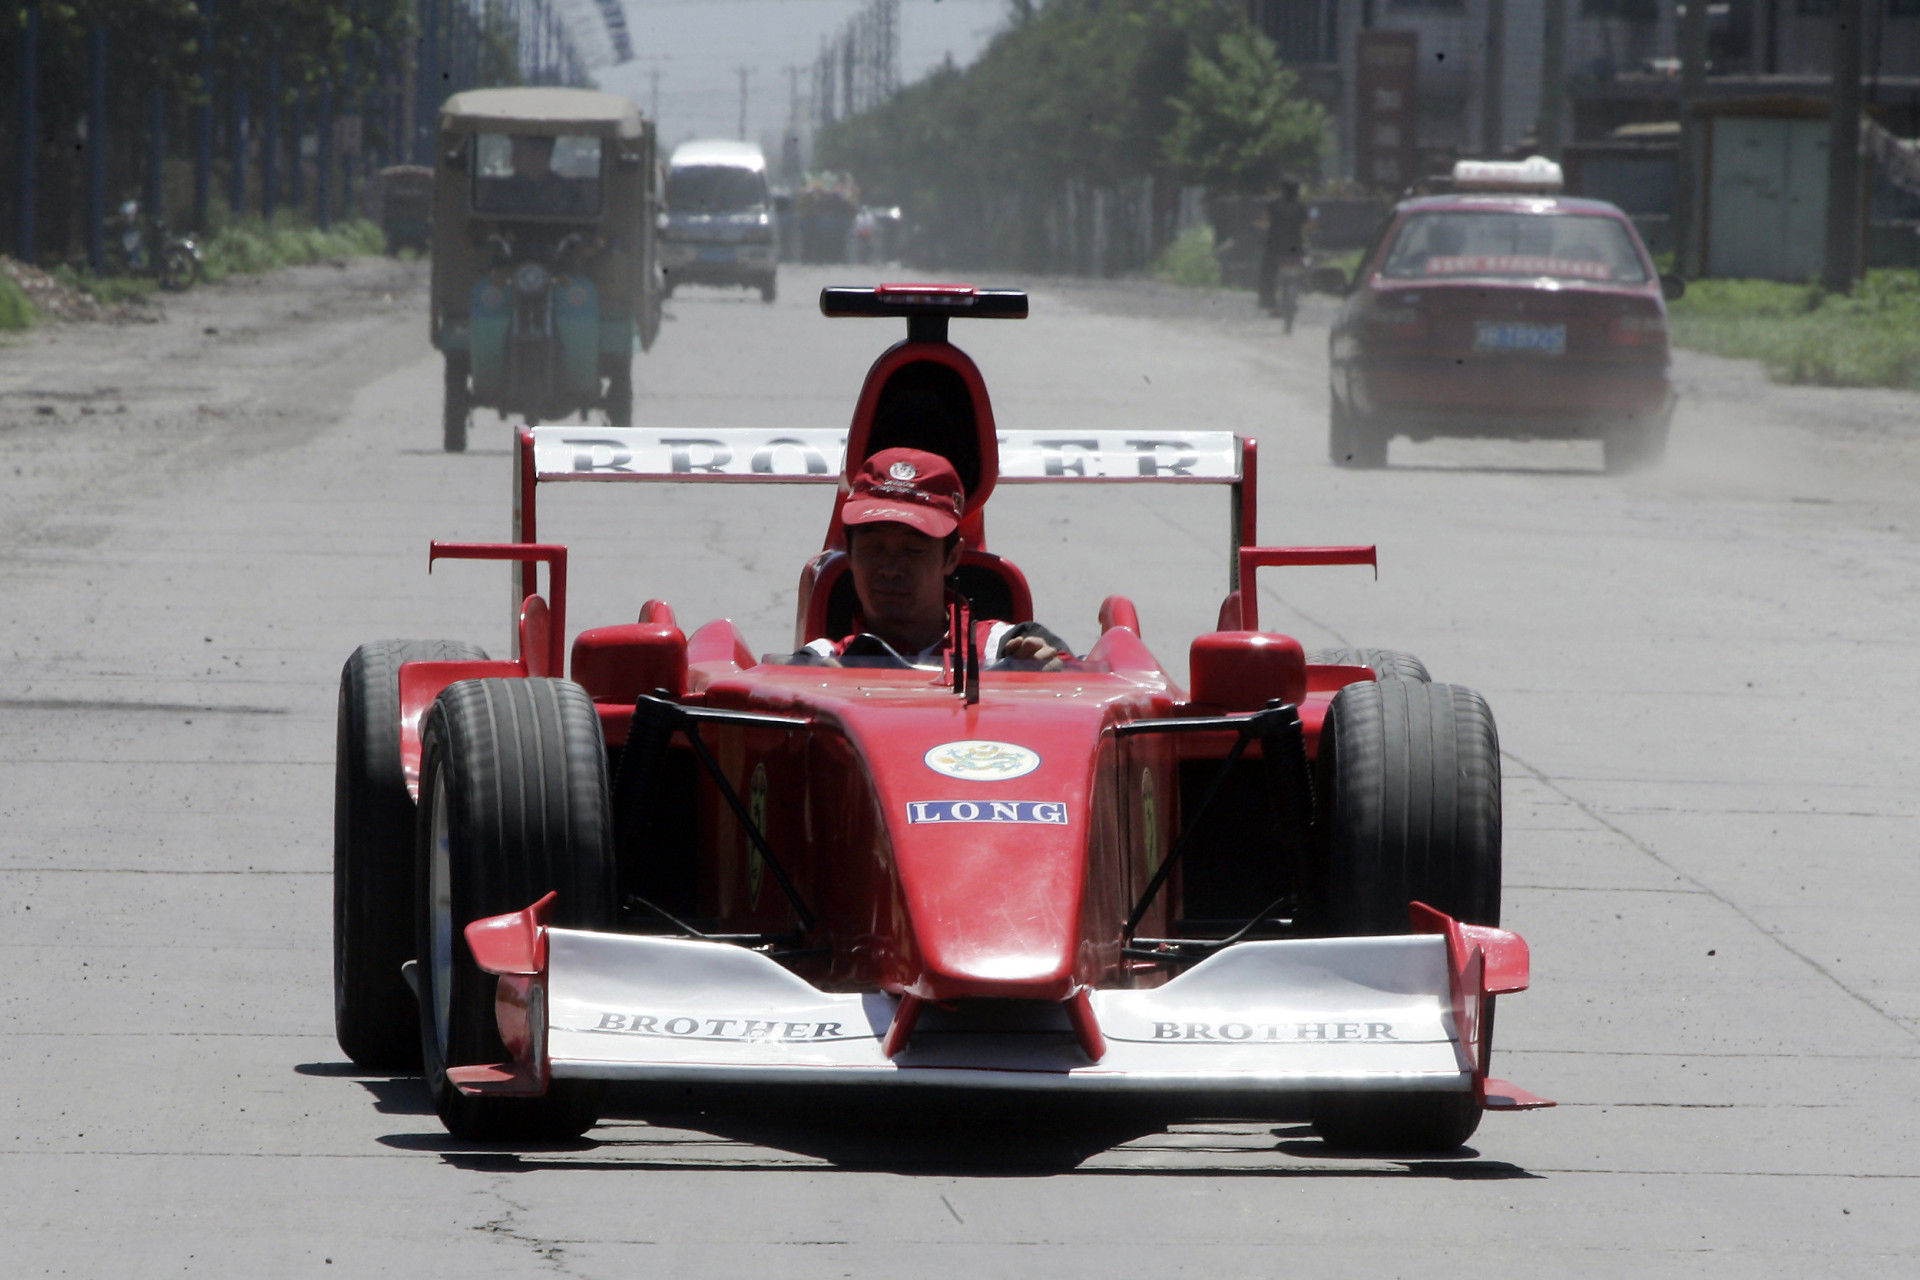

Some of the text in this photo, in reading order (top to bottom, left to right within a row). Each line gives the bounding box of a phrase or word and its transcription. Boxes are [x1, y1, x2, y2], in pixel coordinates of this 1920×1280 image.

[913, 802, 1061, 822] LONG
[594, 1012, 844, 1038] BROTHER
[1151, 1021, 1399, 1040] BROTHER
